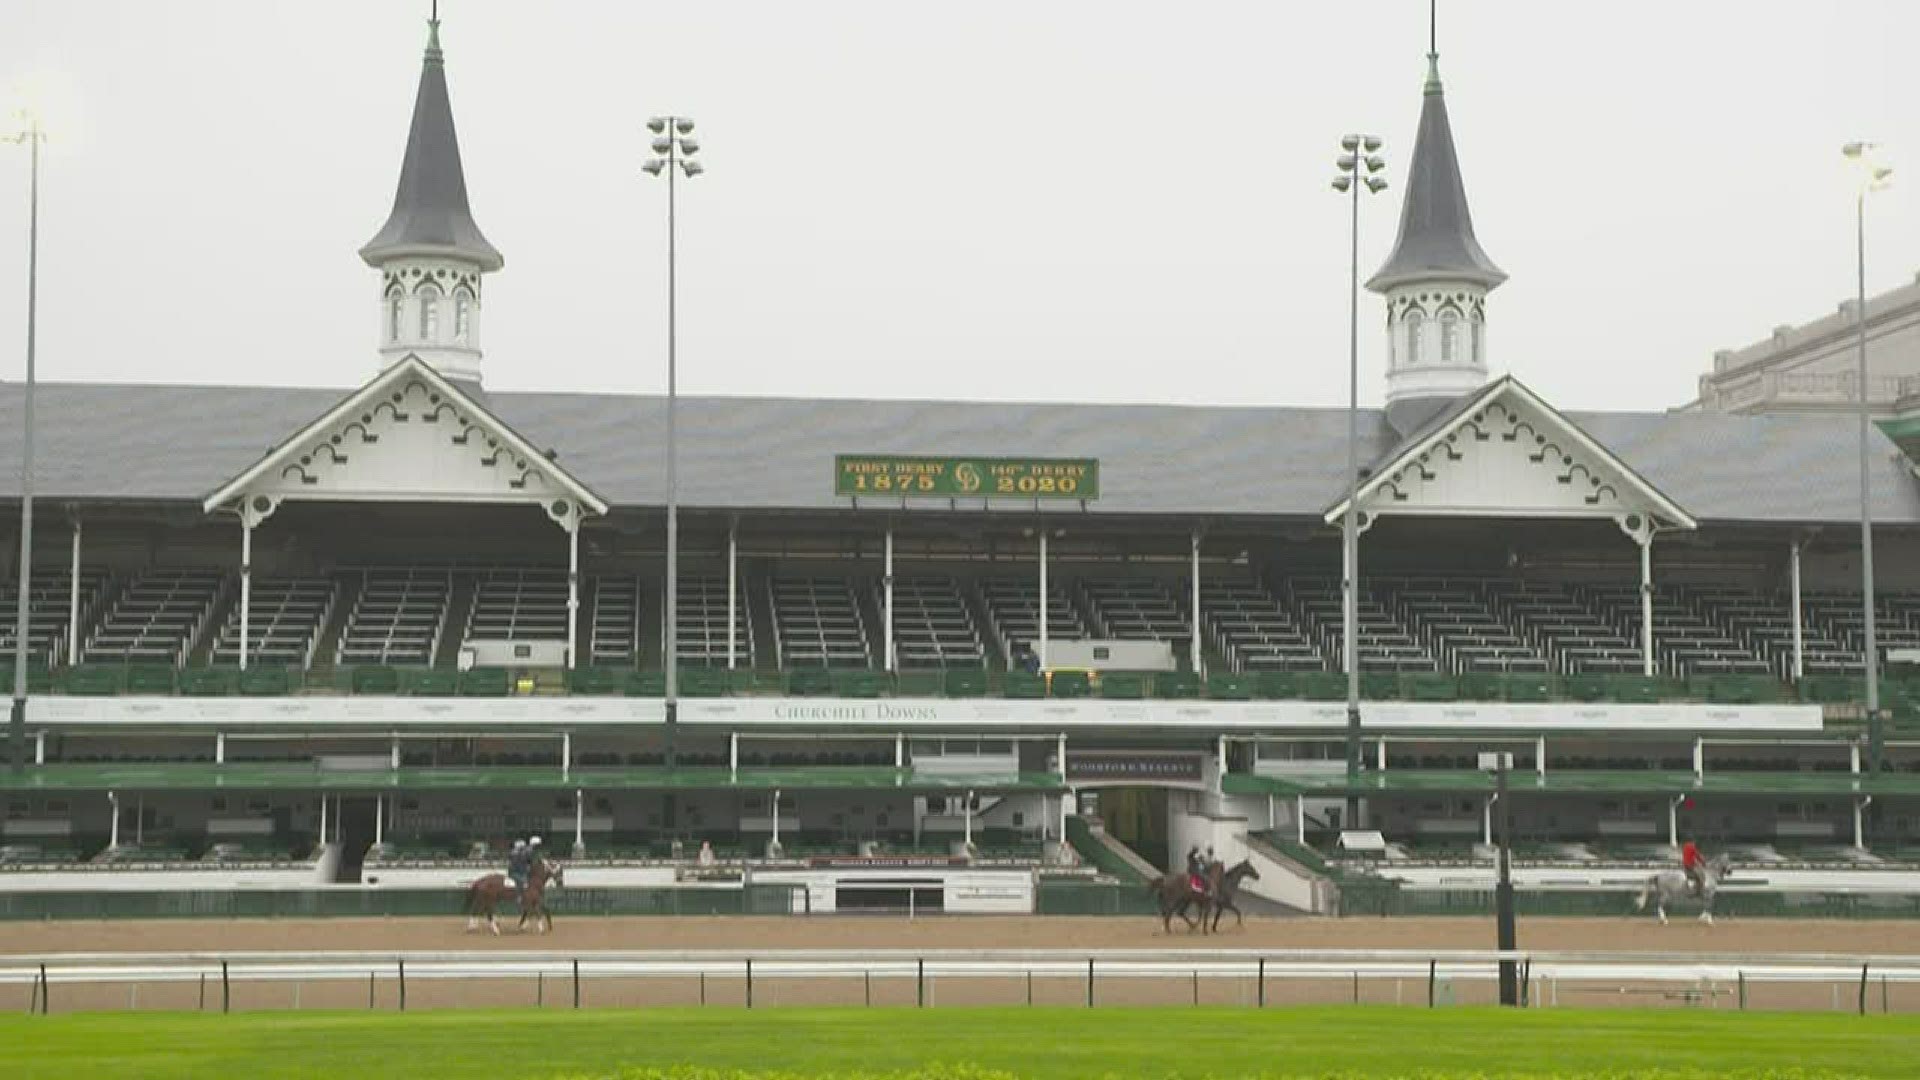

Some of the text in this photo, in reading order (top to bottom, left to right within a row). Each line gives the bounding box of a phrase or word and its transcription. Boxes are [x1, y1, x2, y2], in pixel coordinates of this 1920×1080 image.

[845, 462, 945, 474] FIRST DERBY
[1031, 465, 1086, 477] DERBY
[855, 475, 935, 491] 1875
[998, 476, 1076, 493] 2020
[774, 702, 938, 720] CHURCHILL DOWNS
